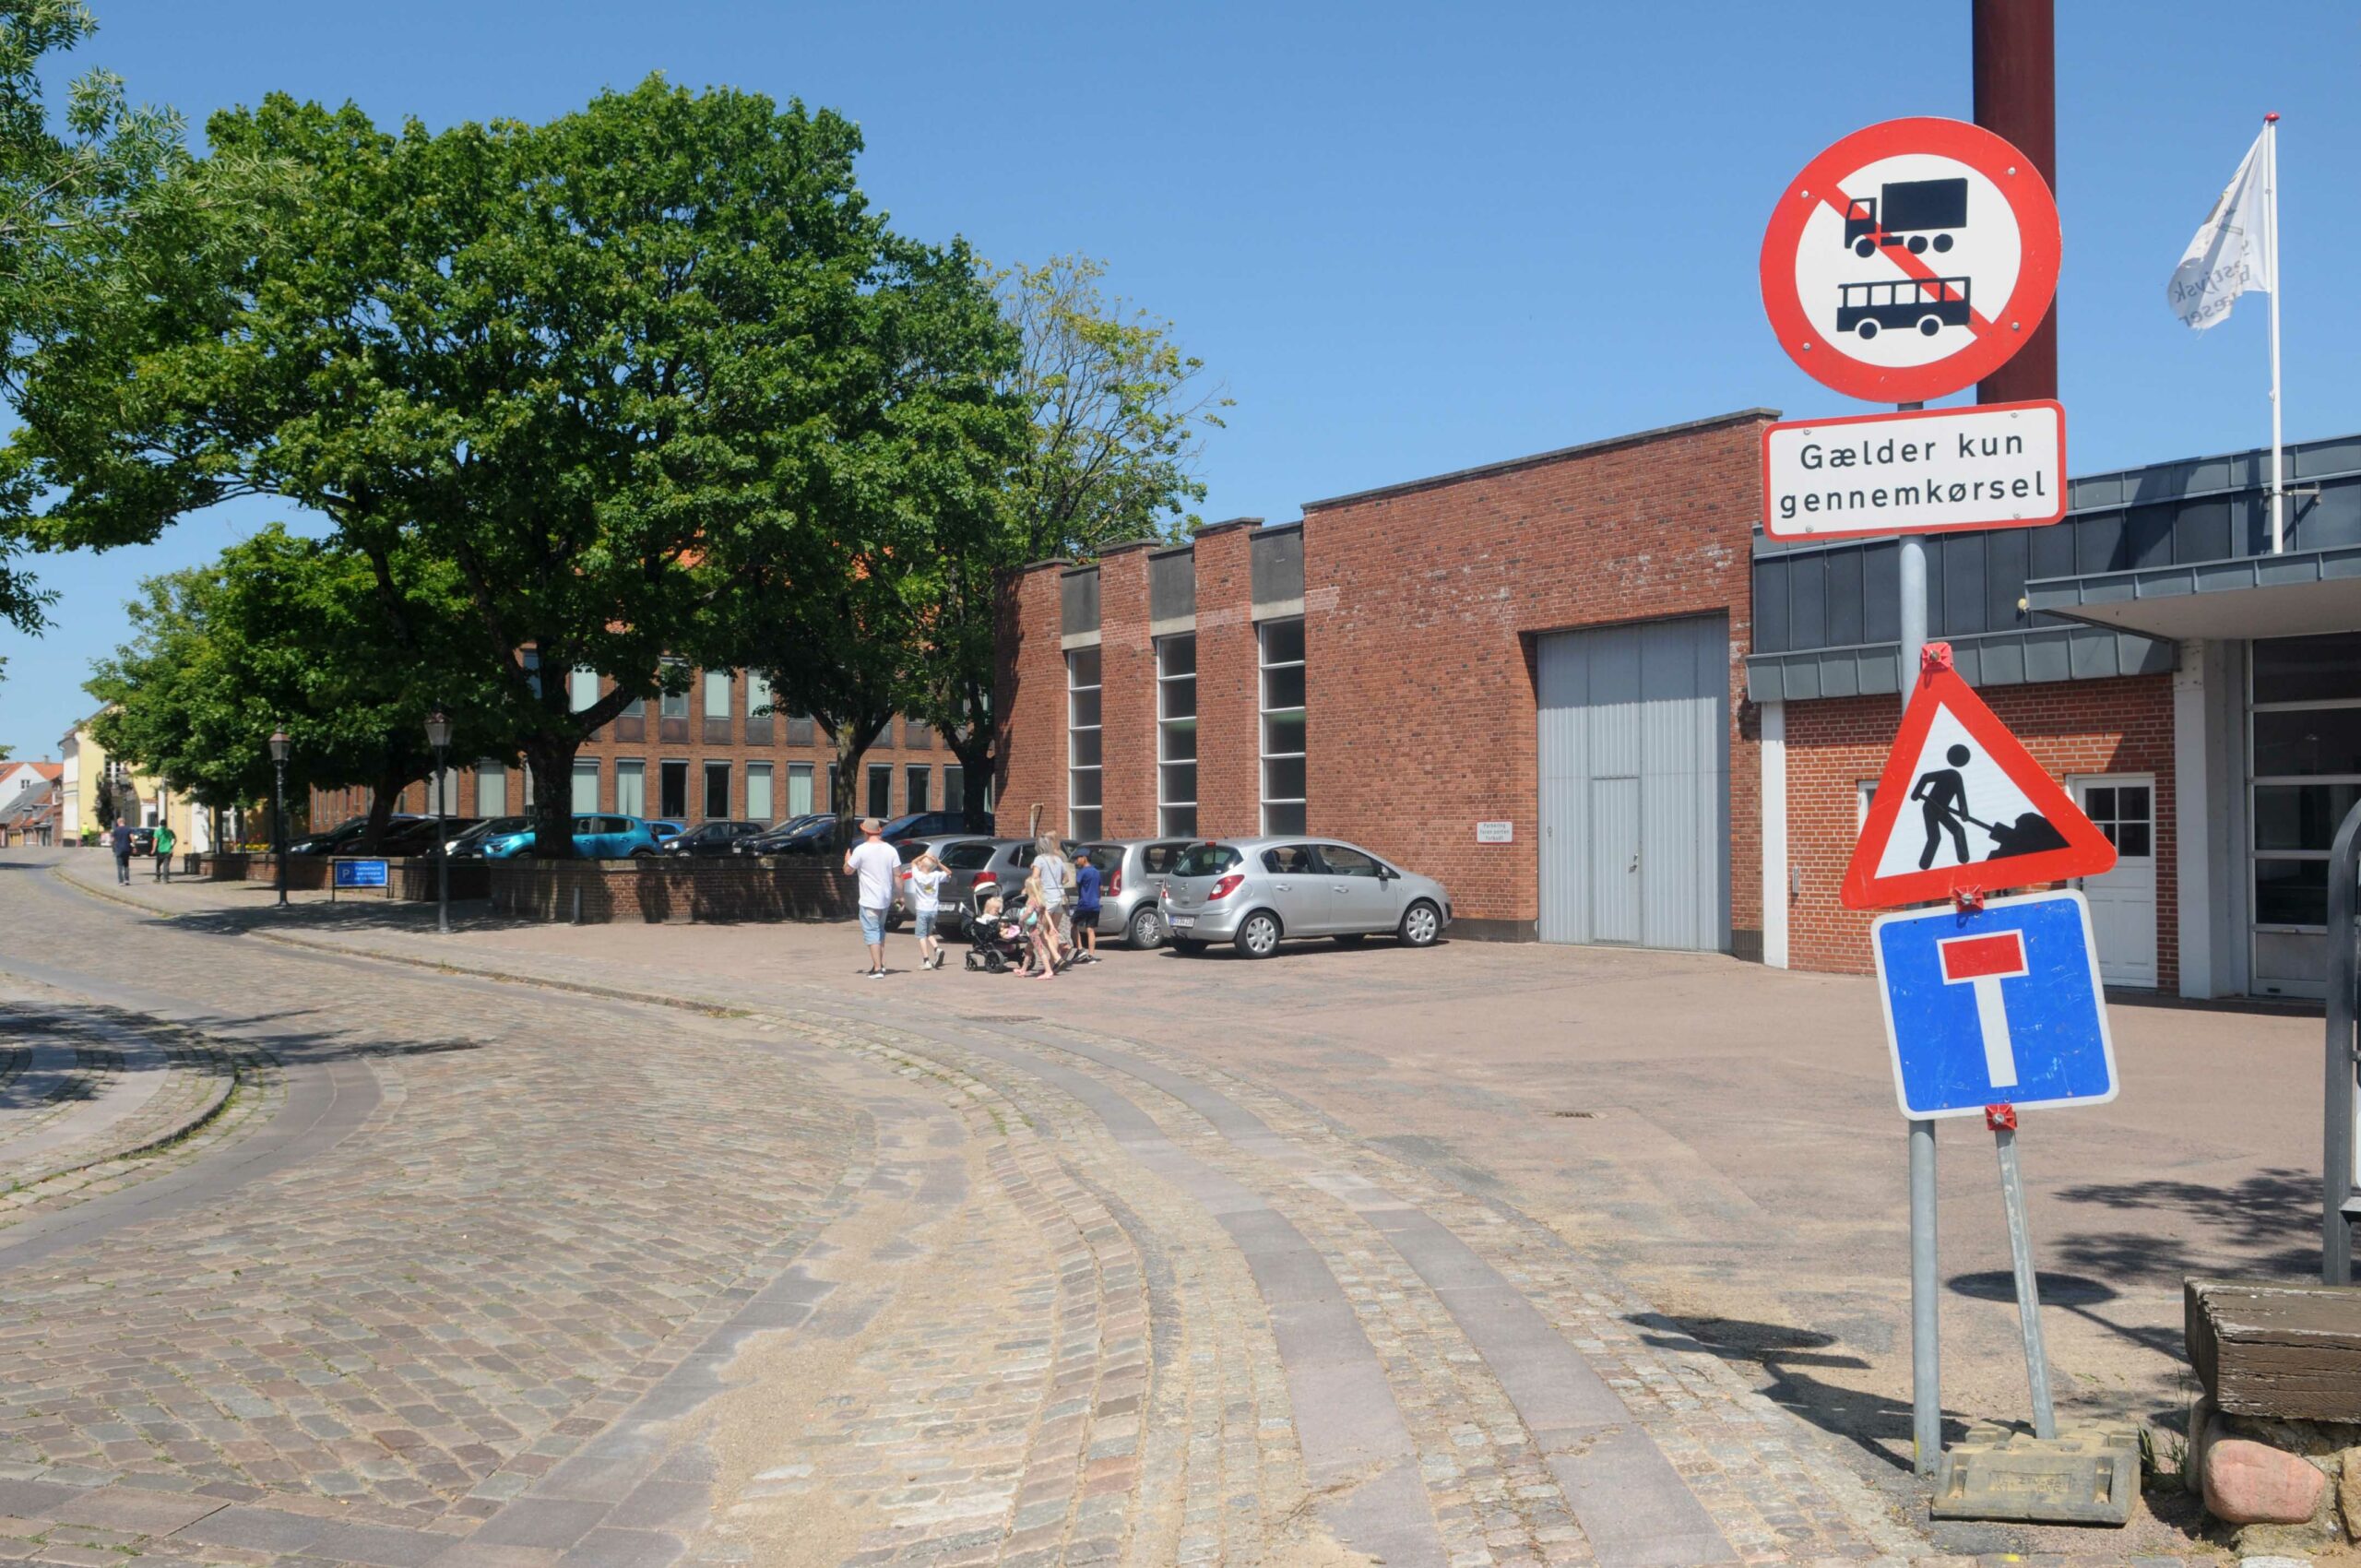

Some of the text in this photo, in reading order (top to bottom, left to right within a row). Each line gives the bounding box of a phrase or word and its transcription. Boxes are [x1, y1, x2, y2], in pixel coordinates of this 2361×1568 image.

[1800, 433, 2023, 469] Gælder kun
[1780, 470, 2046, 519] gennemkørsel
